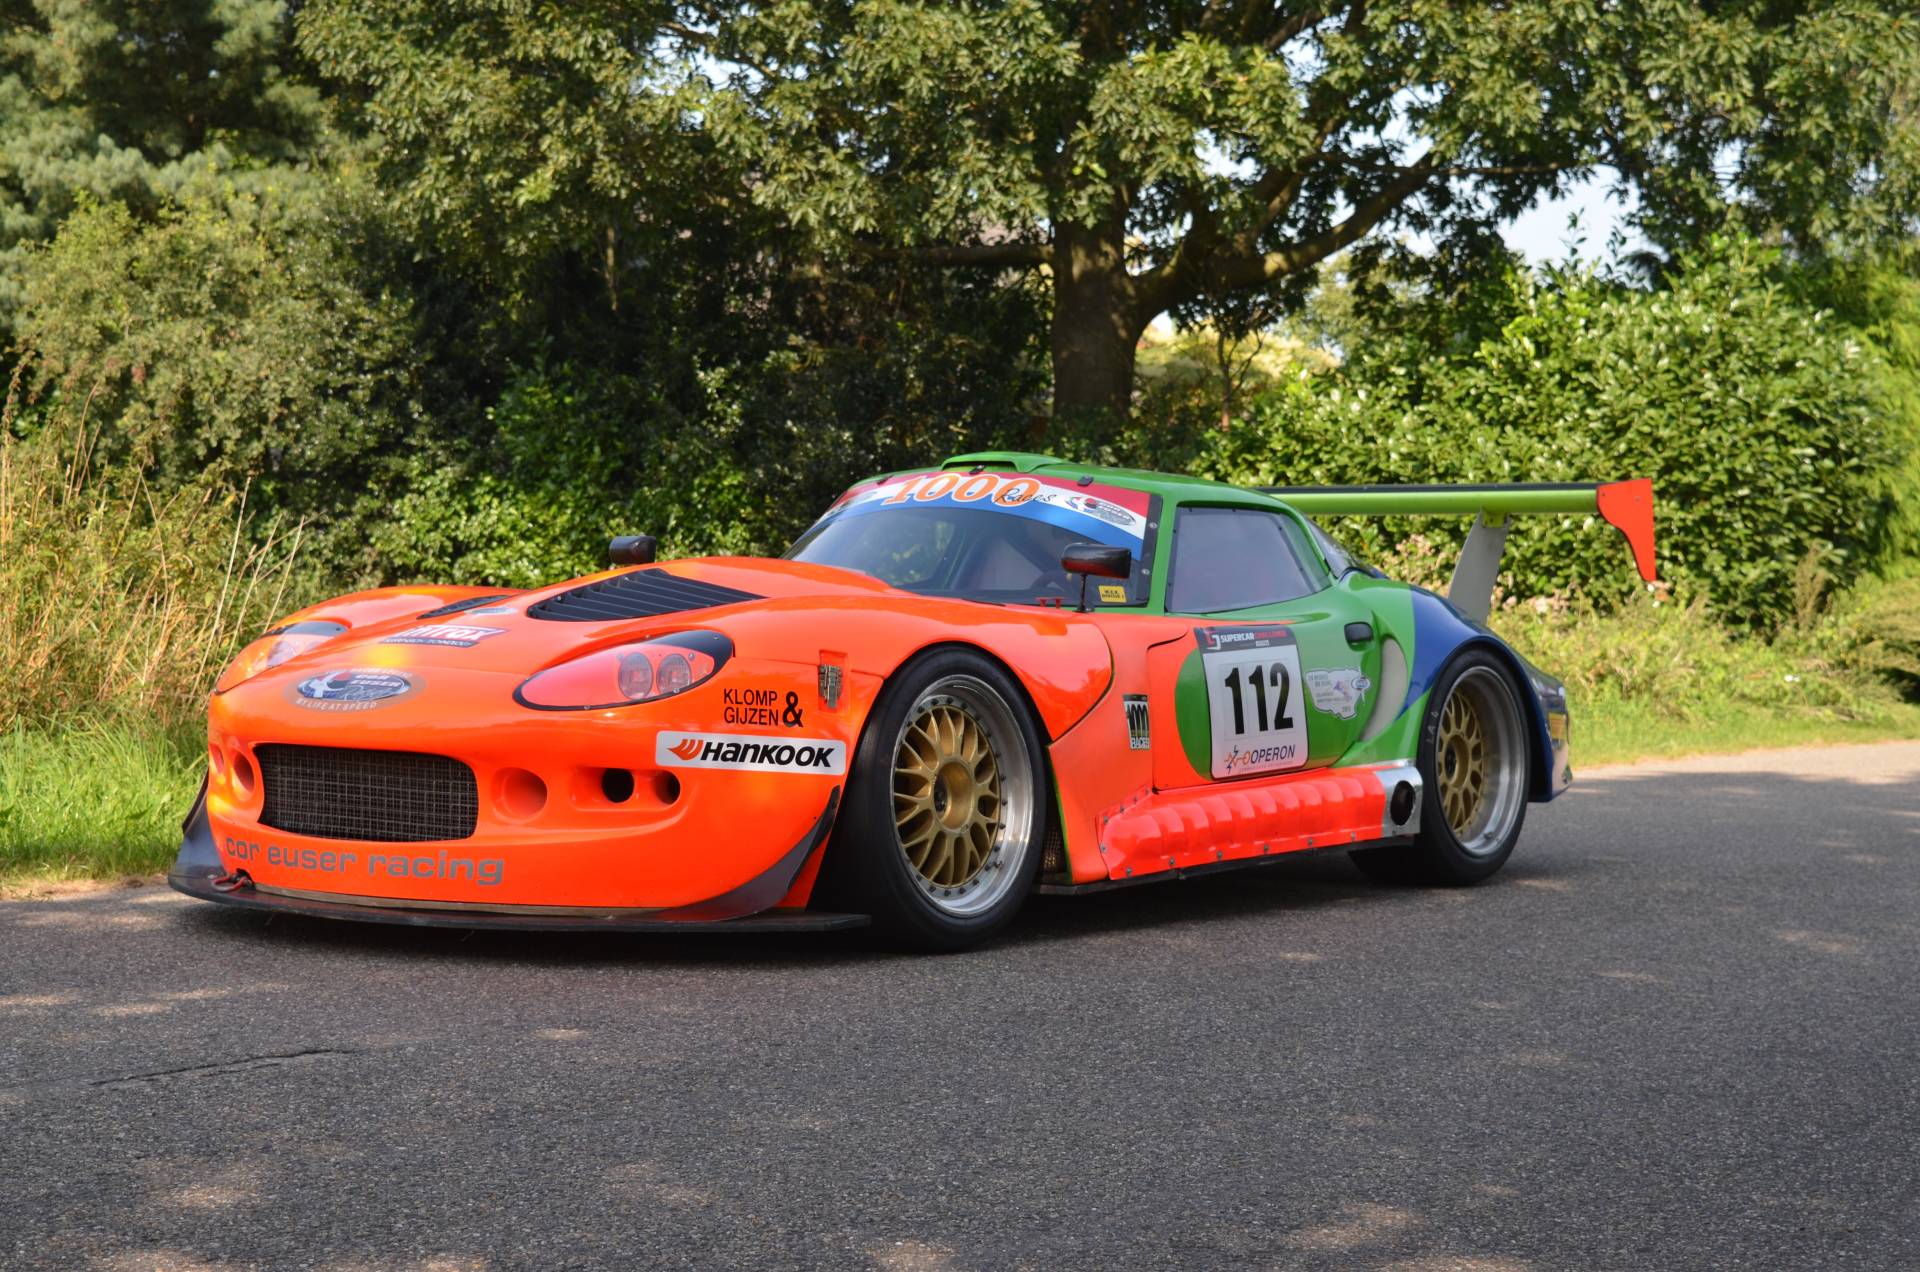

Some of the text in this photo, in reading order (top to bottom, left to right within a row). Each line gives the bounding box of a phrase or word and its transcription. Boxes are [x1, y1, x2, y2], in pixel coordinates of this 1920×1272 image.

[881, 473, 1042, 507] 1000
[1220, 632, 1255, 643] SUPERCAR
[342, 701, 377, 711] SPEED
[723, 688, 778, 706] KLOMP
[782, 691, 804, 728] &
[1225, 662, 1294, 734] 112
[723, 707, 779, 726] GIJZEN
[226, 837, 505, 886] cor euser racing
